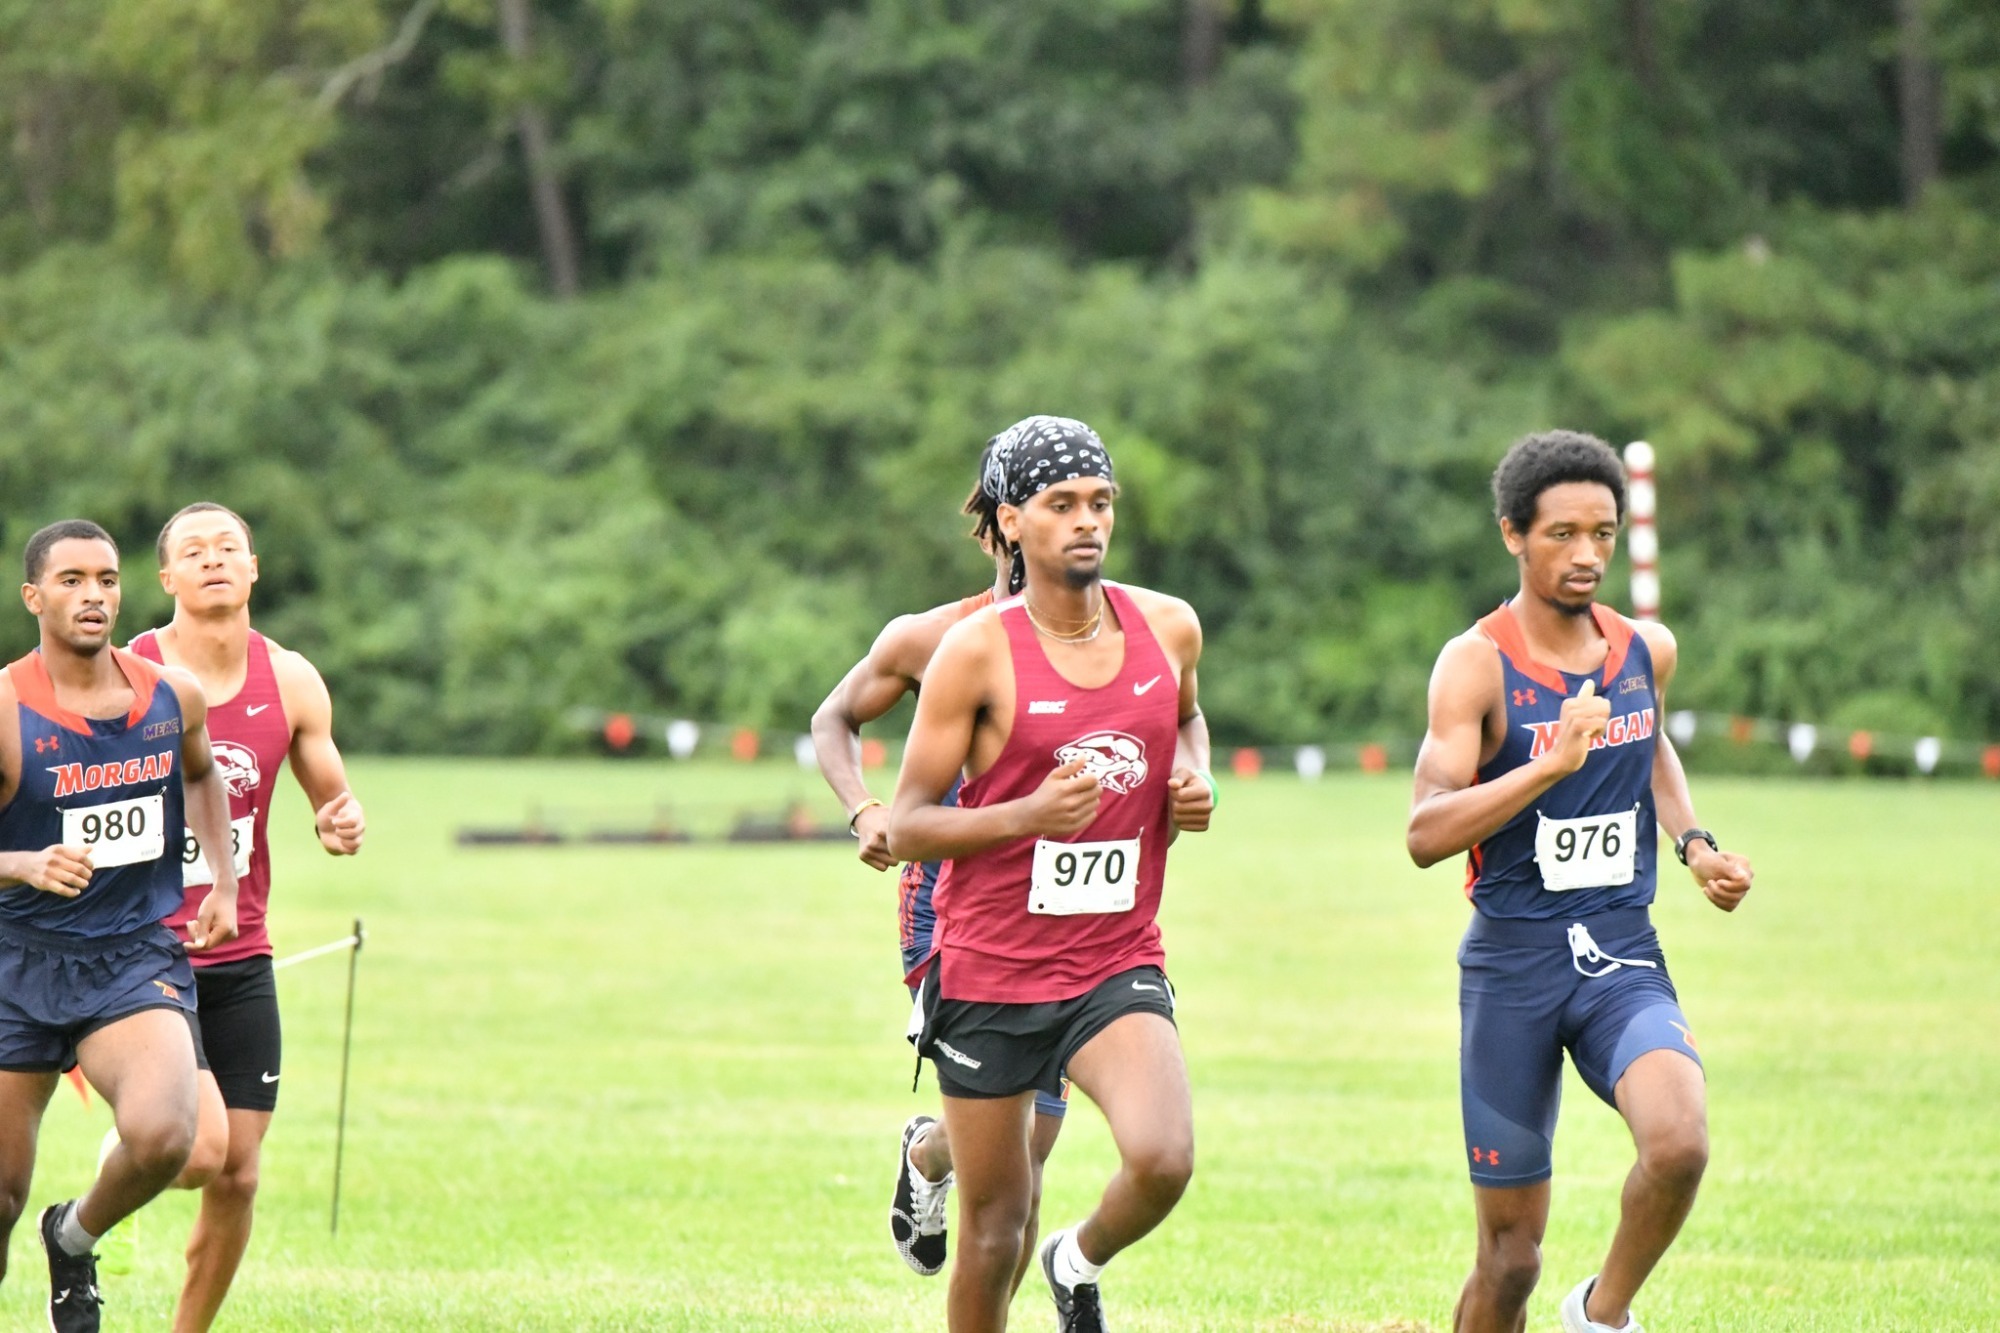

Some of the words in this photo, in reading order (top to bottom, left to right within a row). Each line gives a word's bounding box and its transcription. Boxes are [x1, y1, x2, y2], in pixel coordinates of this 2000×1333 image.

[1521, 708, 1655, 759] MGAN
[46, 751, 173, 797] MORGAN
[82, 806, 145, 844] 980
[1555, 822, 1621, 862] 976
[1054, 849, 1125, 886] 970
